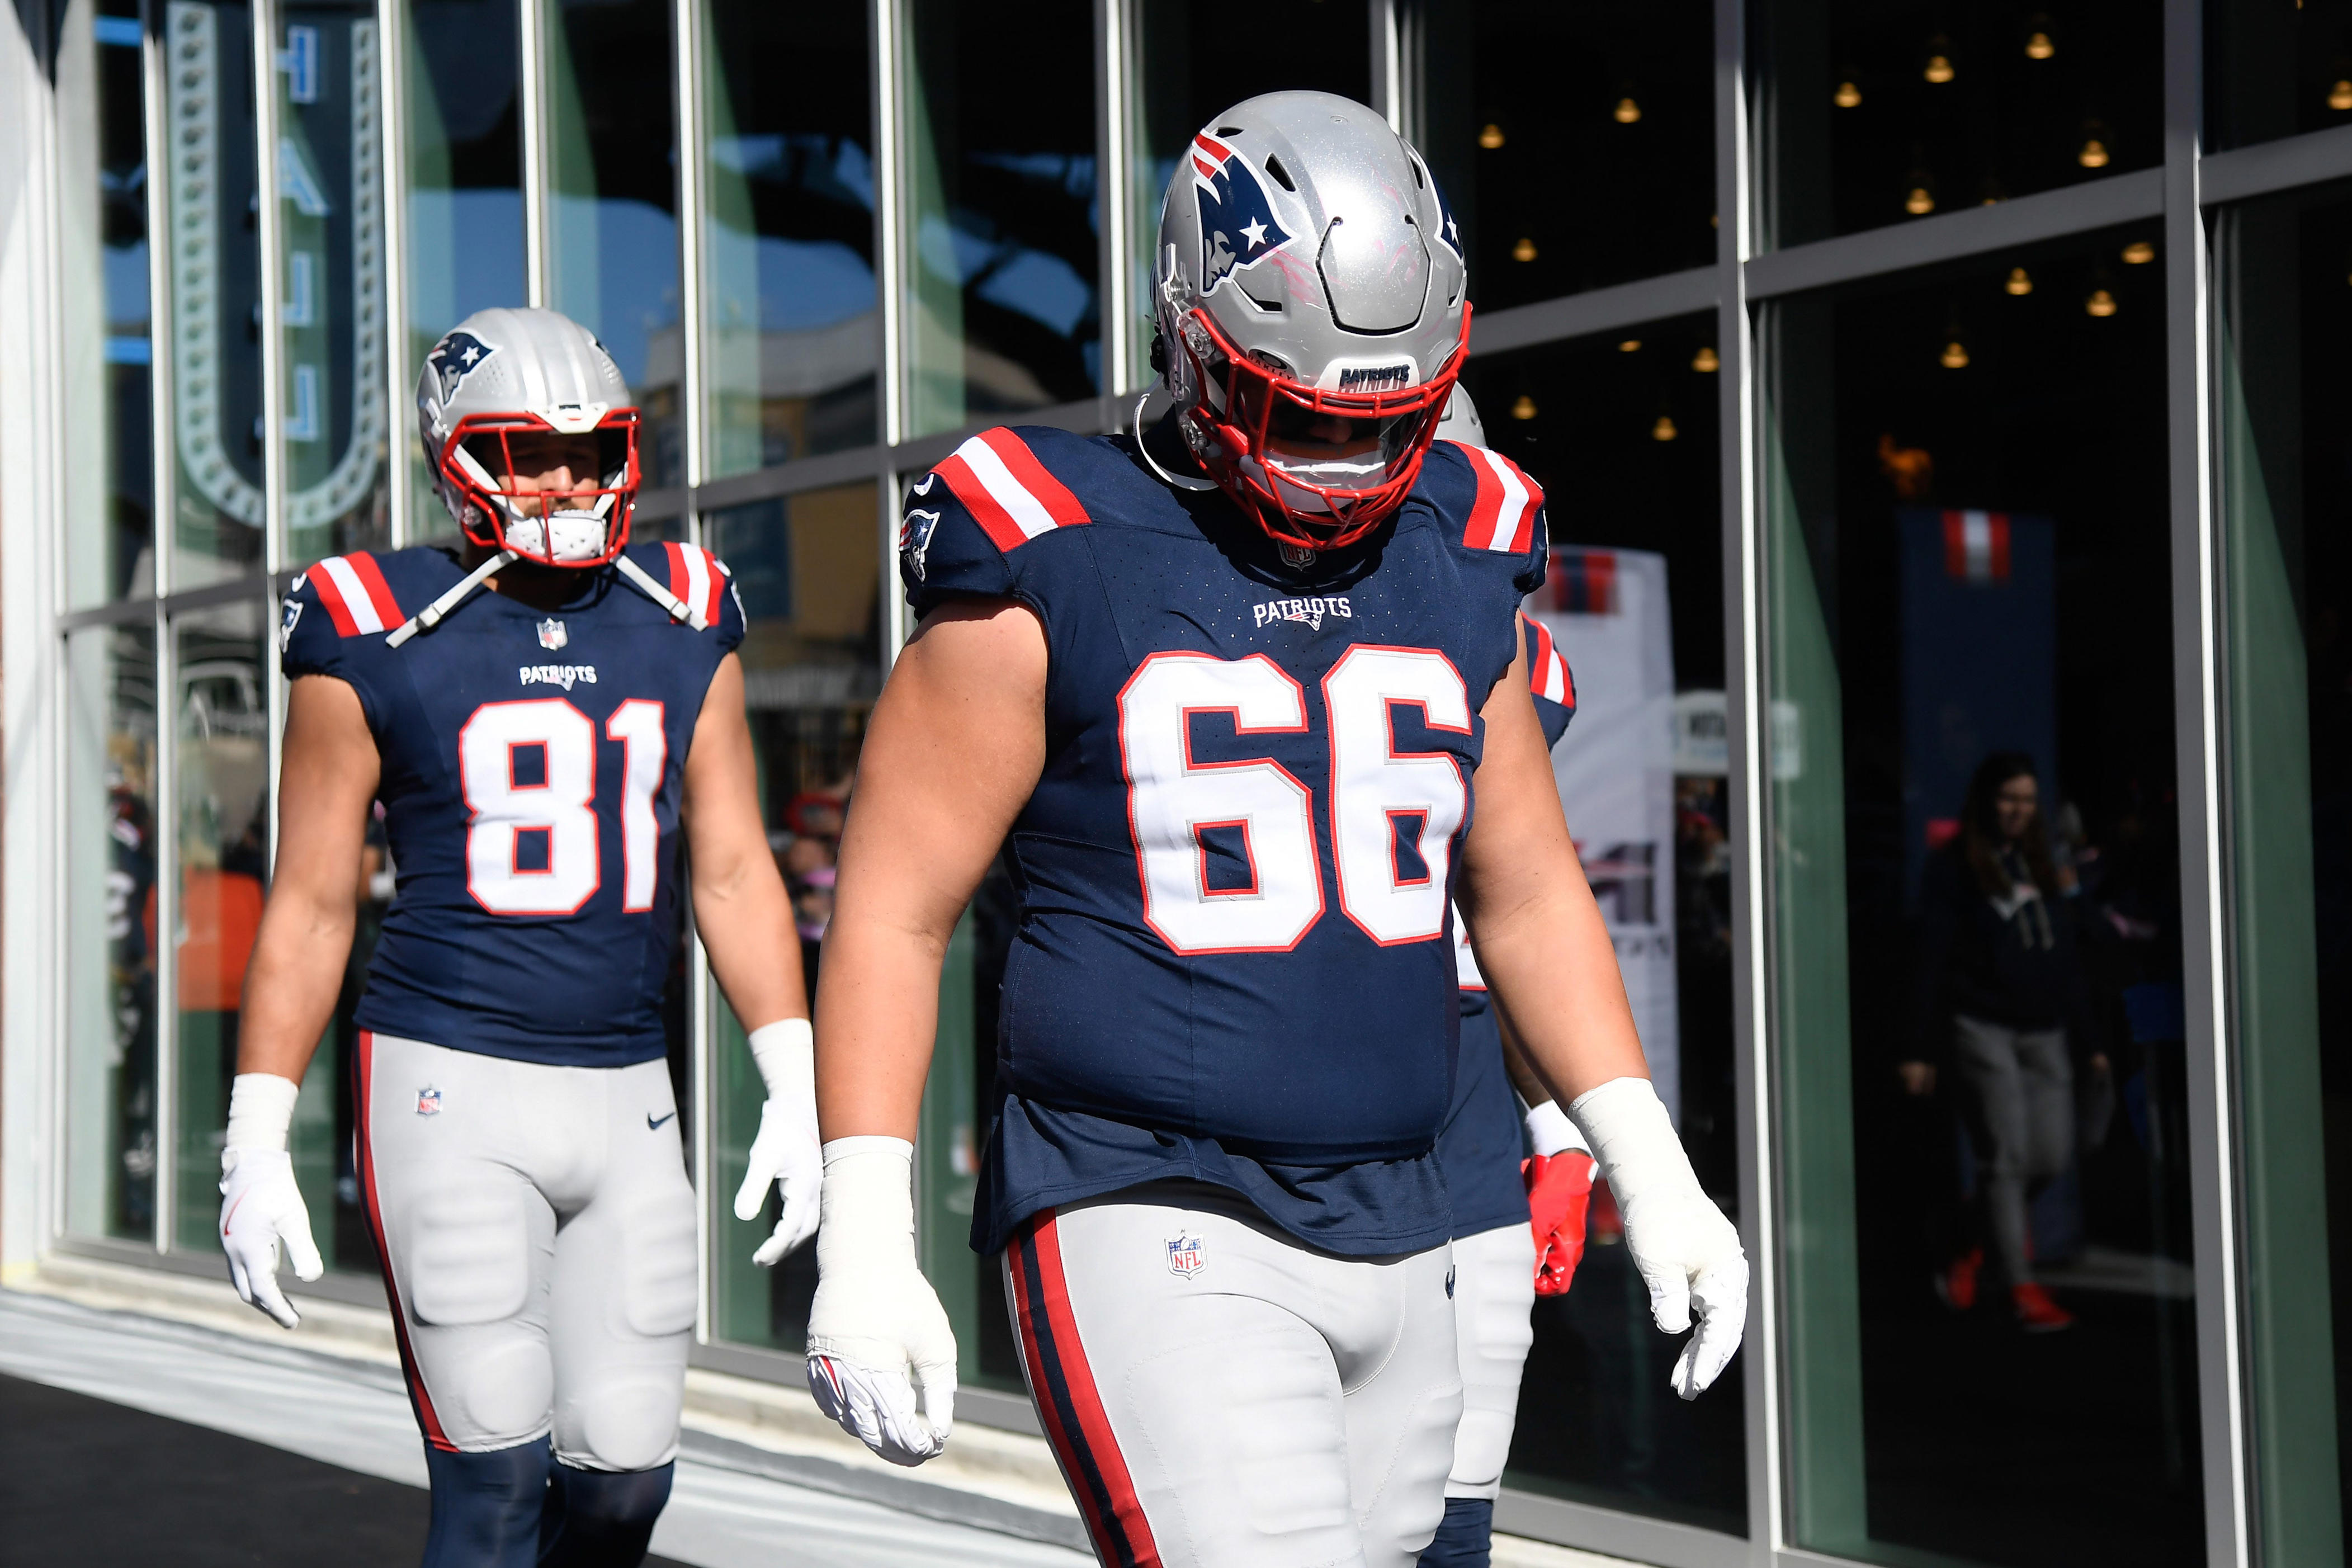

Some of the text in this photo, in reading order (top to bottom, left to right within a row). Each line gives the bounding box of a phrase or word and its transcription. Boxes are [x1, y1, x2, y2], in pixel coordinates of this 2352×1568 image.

[1340, 364, 1410, 386] PATRIOTS
[1287, 546, 1310, 561] NFL
[1253, 597, 1352, 628] PATRIOTS
[519, 665, 597, 686] PATRIOTS
[459, 697, 668, 915] 81
[1116, 643, 1472, 956] 66
[1174, 1251, 1201, 1269] NFL
